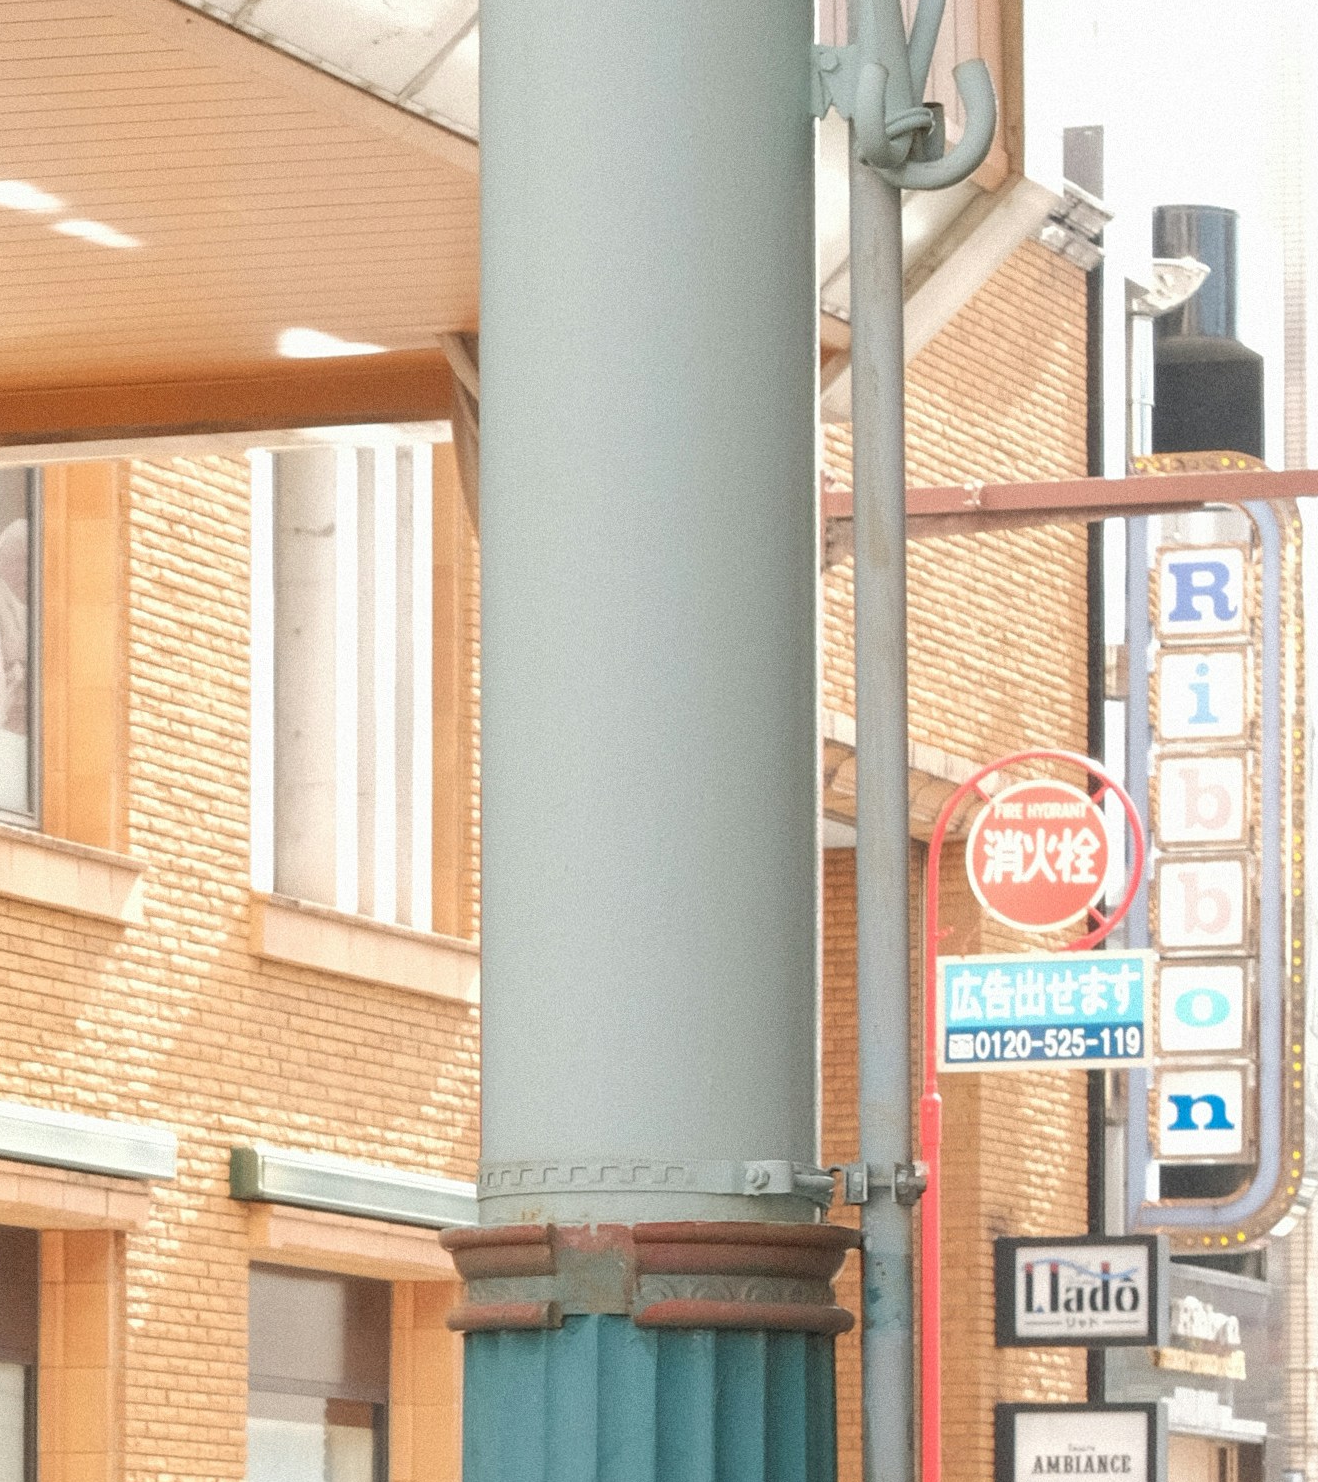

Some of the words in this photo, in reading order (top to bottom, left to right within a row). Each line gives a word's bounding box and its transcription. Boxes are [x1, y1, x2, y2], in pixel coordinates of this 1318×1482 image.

[993, 802, 1023, 819] FIRE
[1027, 802, 1087, 819] HYDRANT
[982, 828, 1101, 884] 消火栓
[1166, 560, 1237, 1131] Ribbon
[949, 964, 1141, 1021] 広告出せます
[975, 1026, 1141, 1060] 0120-525-119
[1030, 1454, 1133, 1475] AMBIANCE
